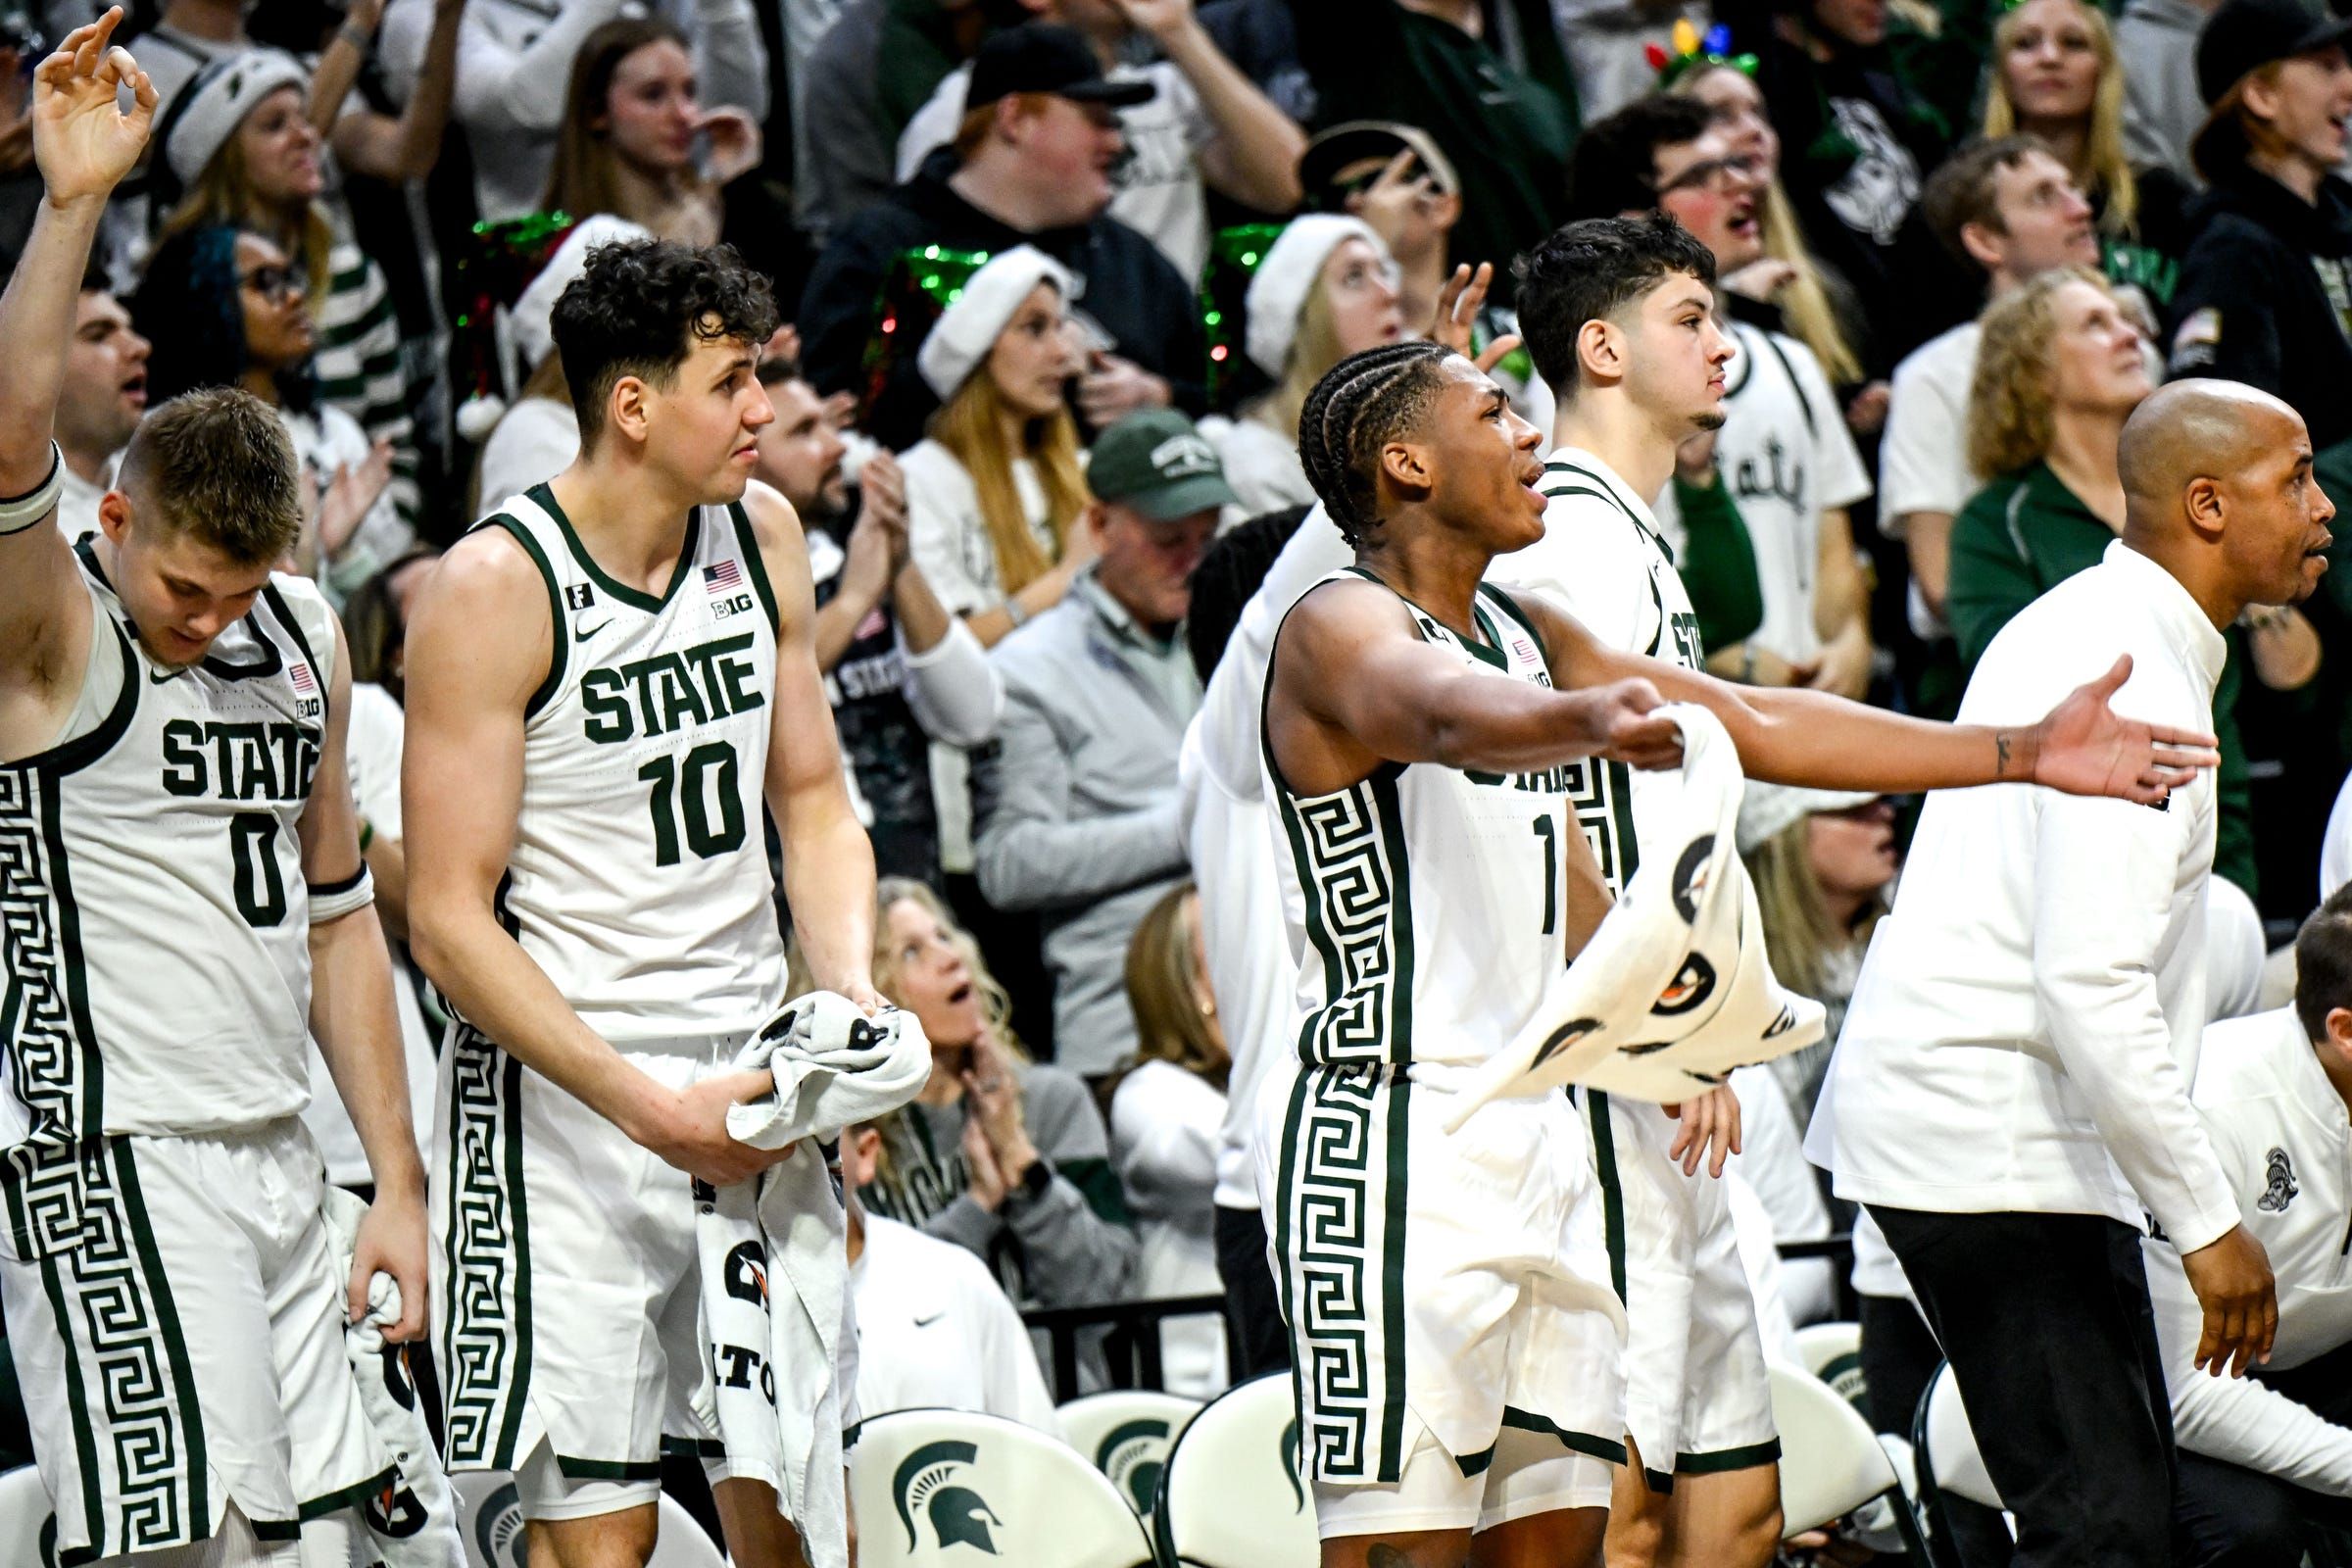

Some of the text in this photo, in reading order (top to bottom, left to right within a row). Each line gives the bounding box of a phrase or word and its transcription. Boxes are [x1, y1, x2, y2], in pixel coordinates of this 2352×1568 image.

[710, 593, 754, 620] B1G
[579, 631, 765, 745] STATE
[162, 718, 321, 801] STATE
[638, 740, 747, 867] 10
[228, 811, 287, 928] 0
[1533, 813, 1556, 935] 1
